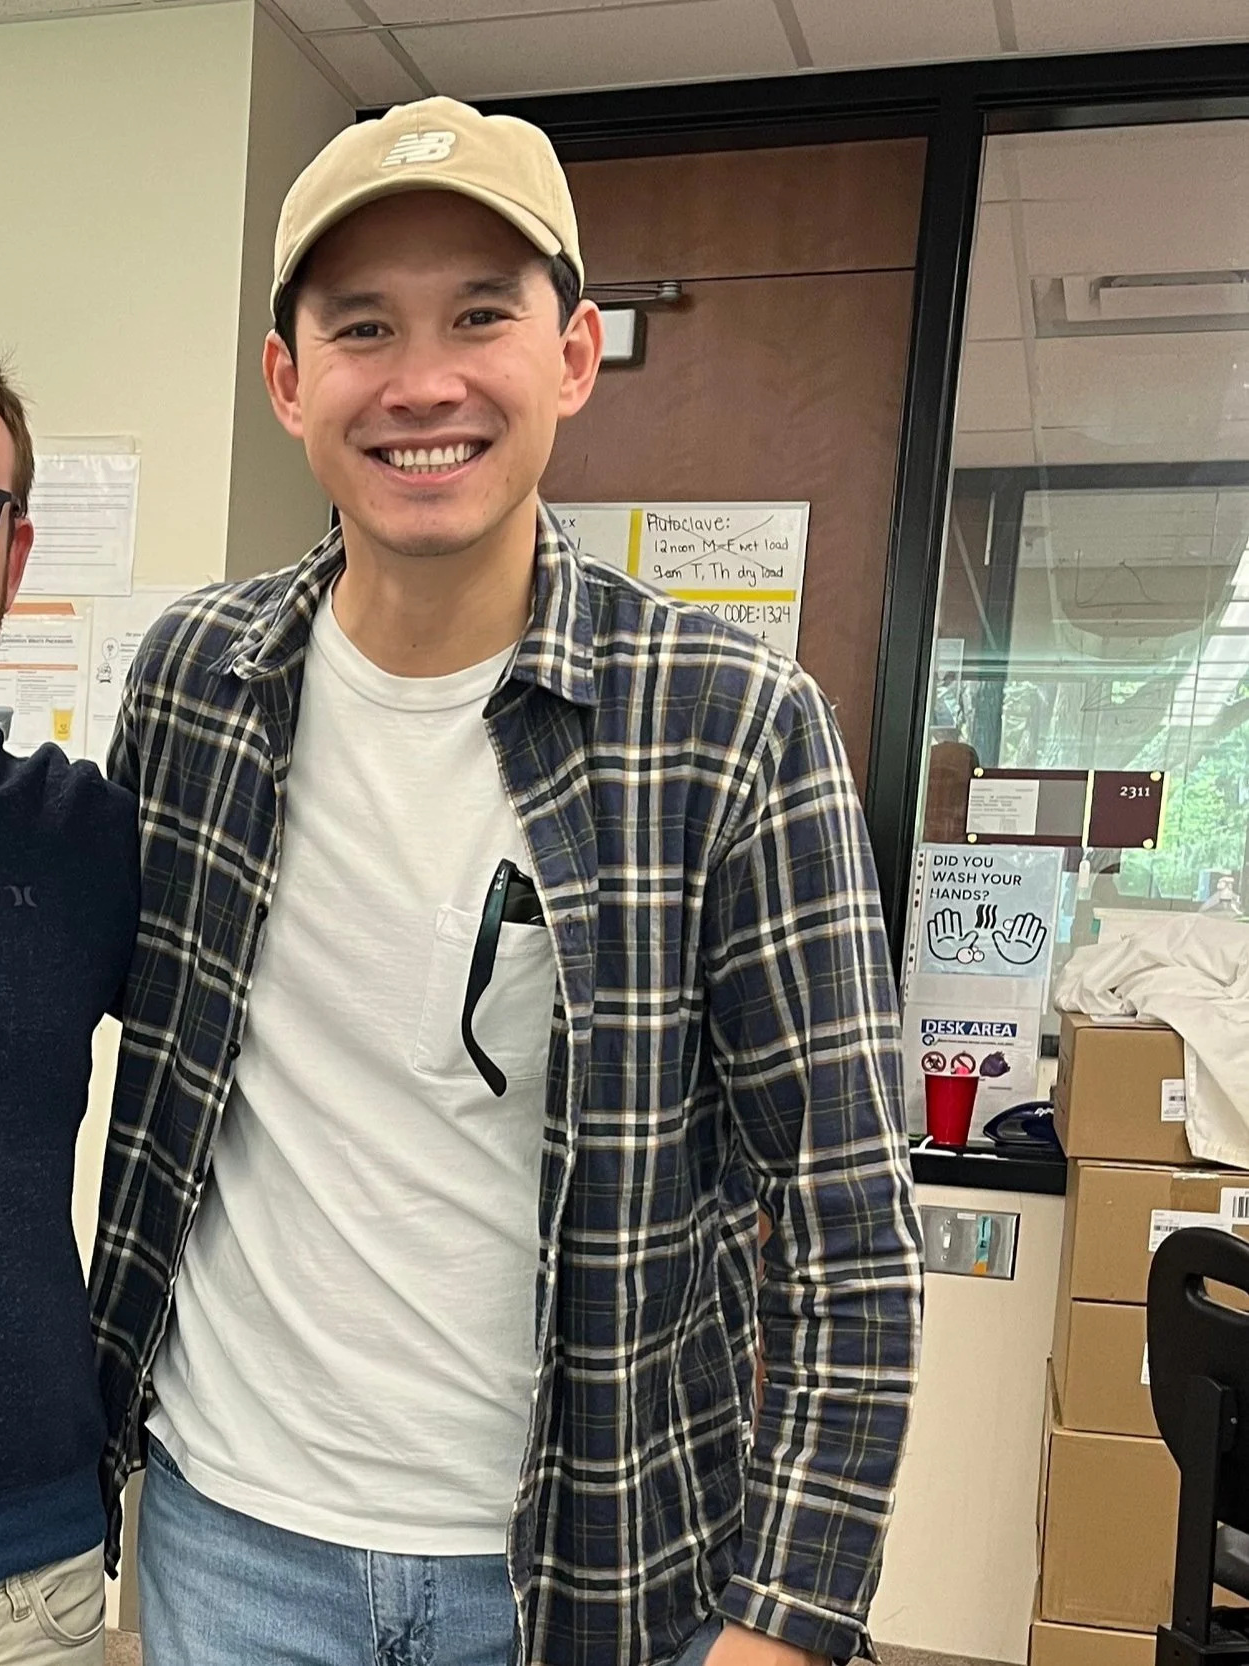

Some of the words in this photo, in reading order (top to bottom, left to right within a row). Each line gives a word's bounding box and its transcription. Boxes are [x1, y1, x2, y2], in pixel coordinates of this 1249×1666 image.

[646, 512, 731, 532] Autoclave:
[764, 538, 789, 551] load
[709, 562, 731, 580] Th
[737, 564, 757, 587] dry
[760, 565, 784, 579] load
[1119, 785, 1151, 799] 2311
[933, 854, 959, 867] DID
[963, 855, 994, 868] YOU
[932, 871, 977, 884] WASH
[981, 872, 1022, 886] YOUR
[930, 887, 990, 901] HANDS?
[925, 1020, 965, 1035] DESK
[969, 1022, 1012, 1037] AREA
